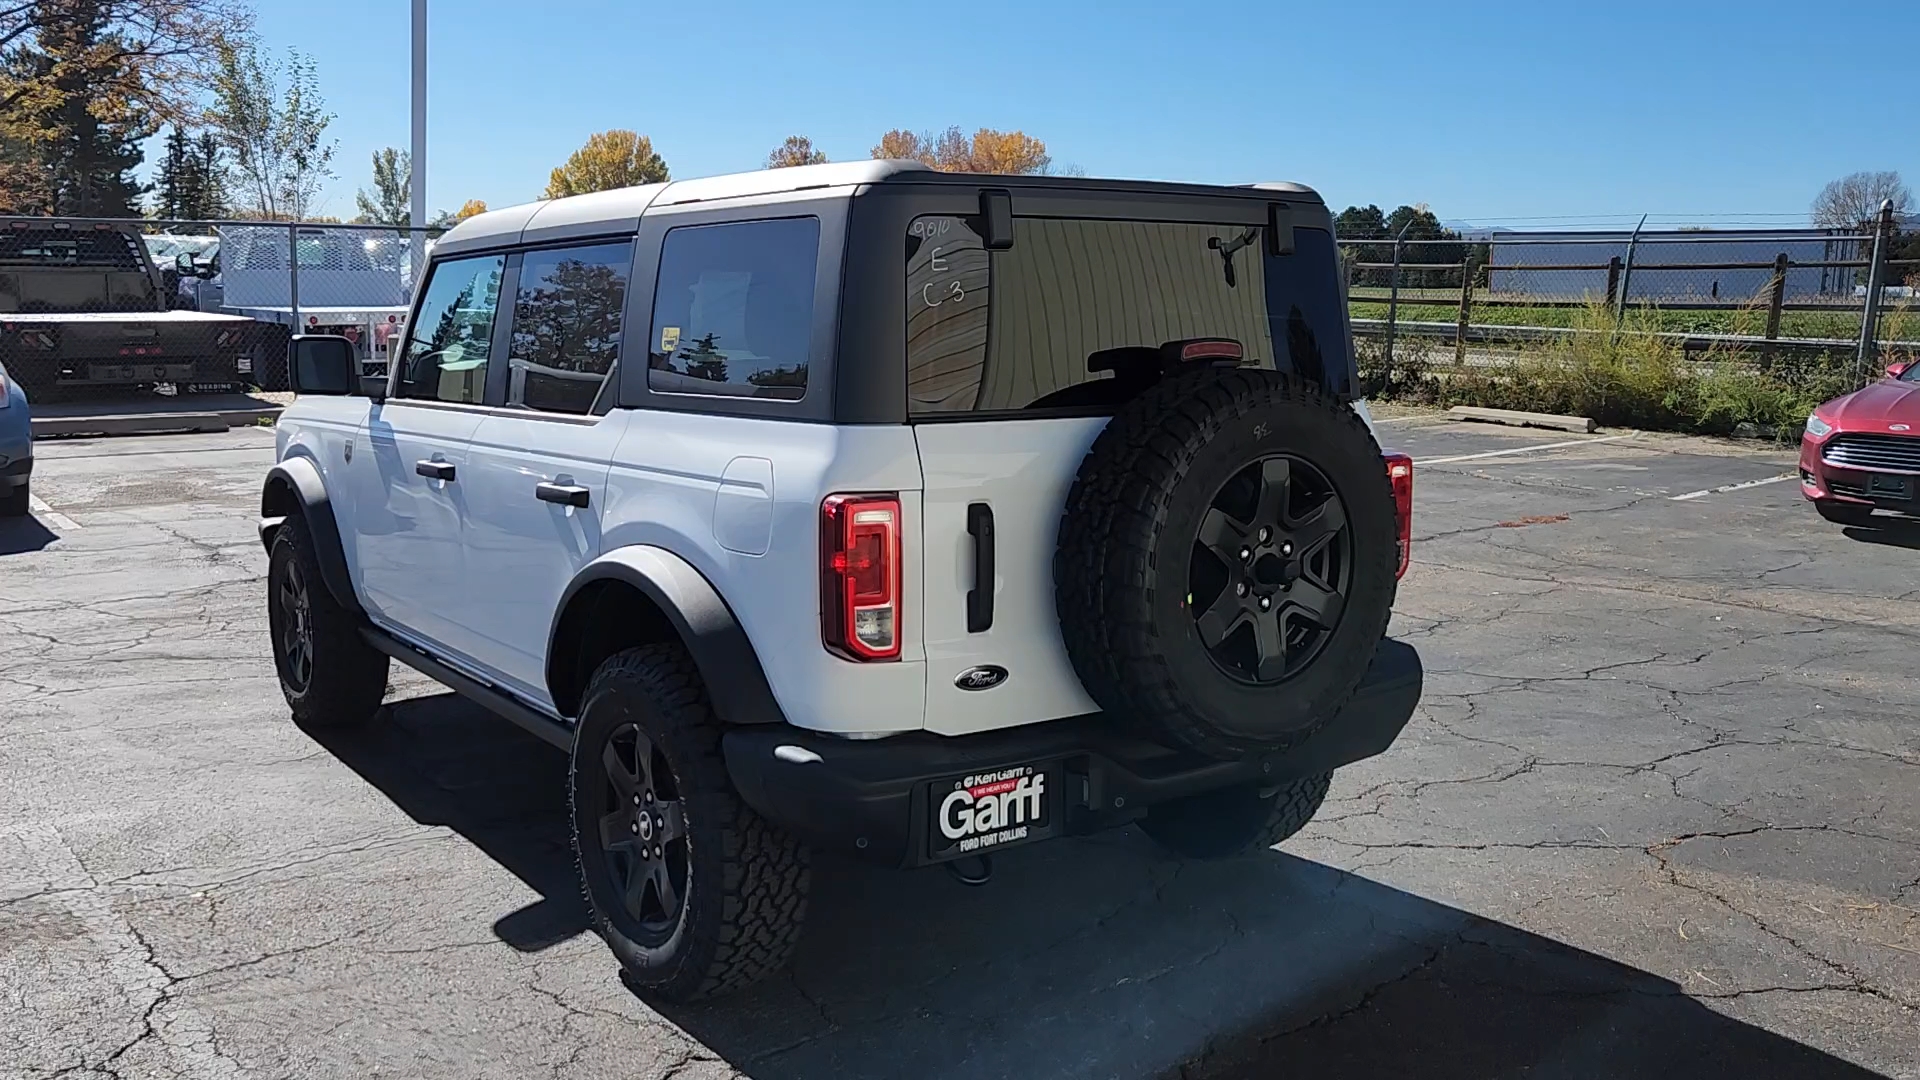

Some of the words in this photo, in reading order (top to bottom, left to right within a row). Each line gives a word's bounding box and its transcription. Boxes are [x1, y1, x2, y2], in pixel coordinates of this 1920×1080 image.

[931, 247, 948, 271] E
[968, 670, 998, 686] Ford
[974, 772, 997, 786] Ken
[939, 773, 1045, 839] Garff
[960, 837, 979, 853] FORD
[980, 832, 998, 848] FORT
[998, 825, 1028, 843] COLLINS
